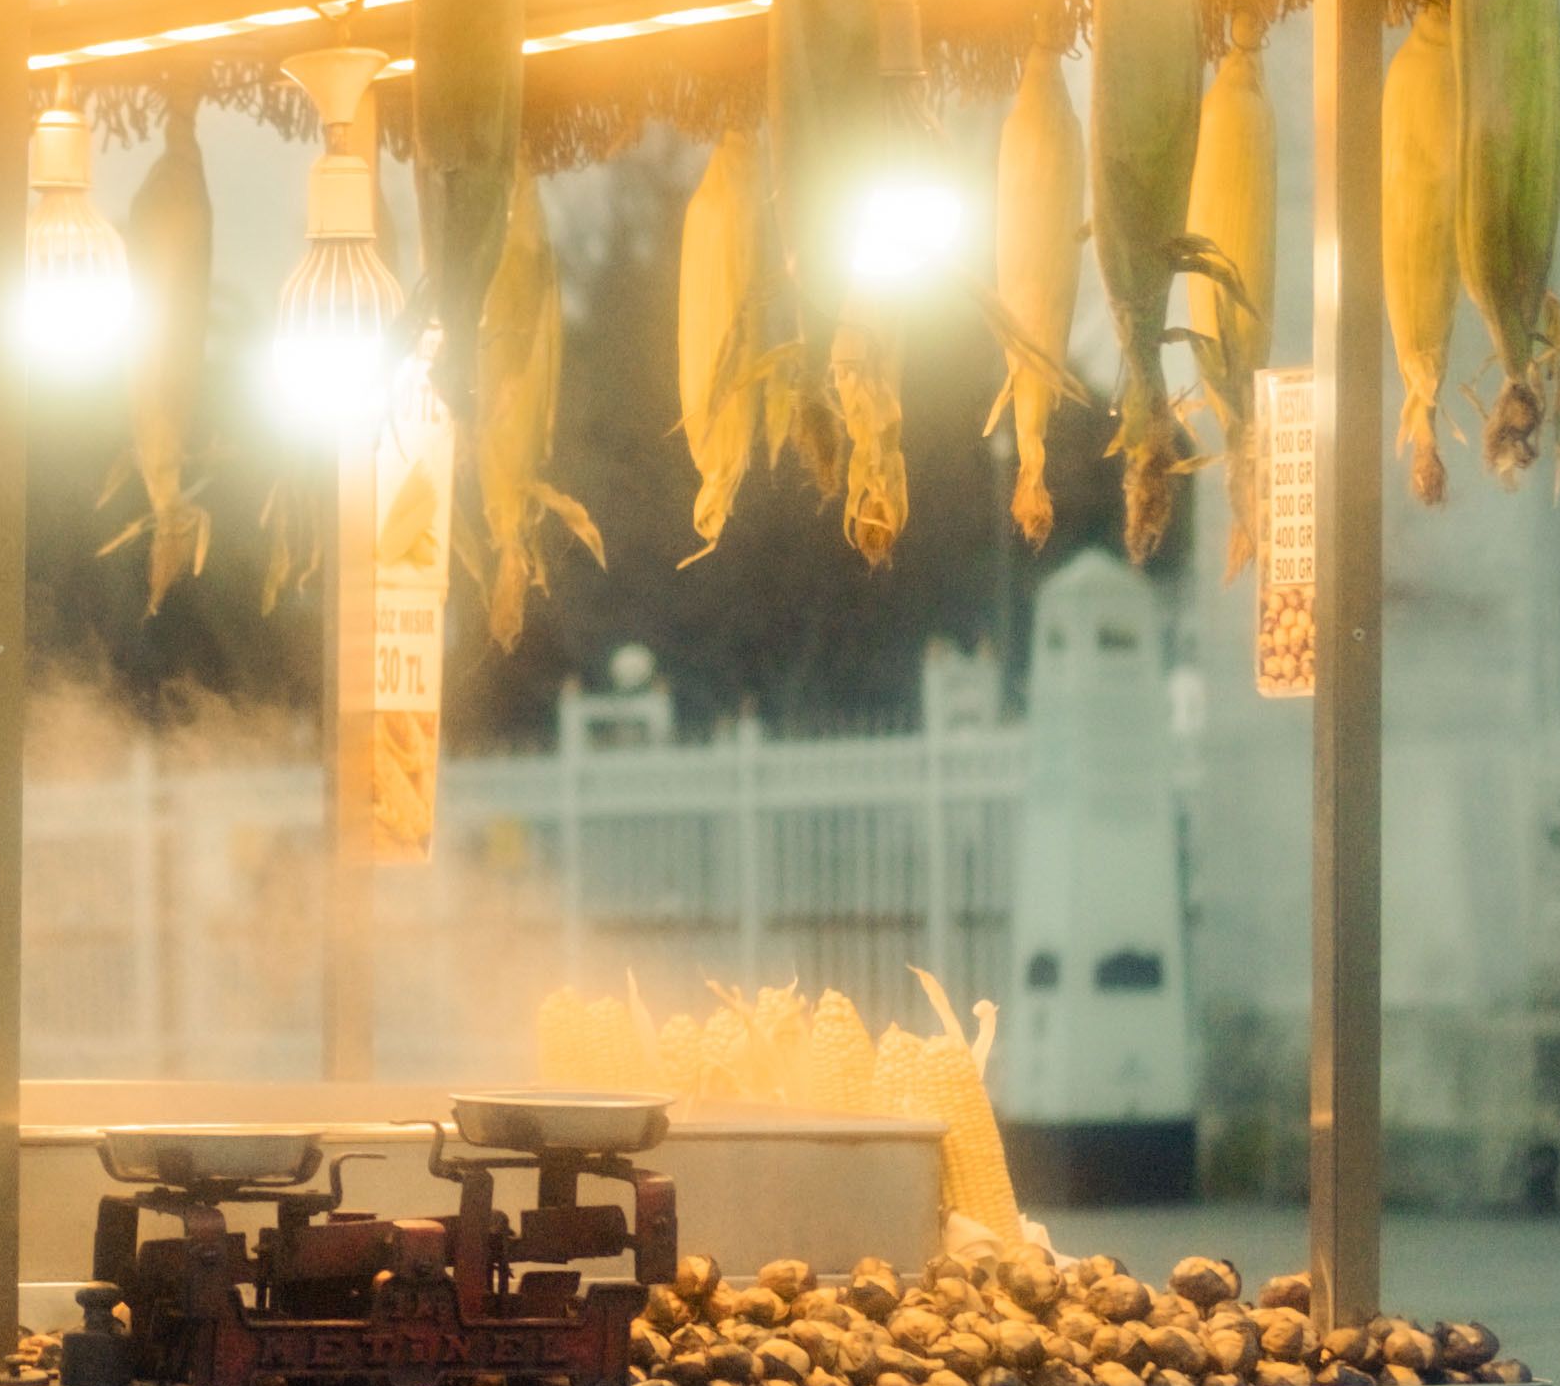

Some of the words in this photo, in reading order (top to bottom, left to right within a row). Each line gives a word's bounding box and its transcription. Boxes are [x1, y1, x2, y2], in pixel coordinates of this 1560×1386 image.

[1275, 430, 1294, 453] 100
[1297, 429, 1313, 452] GR
[1275, 463, 1294, 485] 200
[1297, 462, 1313, 484] GR
[1275, 494, 1294, 517] 300
[1297, 493, 1313, 516] GR
[1275, 526, 1294, 548] 400
[1297, 525, 1313, 547] GR
[1275, 558, 1294, 581] 500
[1297, 557, 1313, 580] GR
[378, 646, 400, 693] 30
[406, 654, 425, 695] TL
